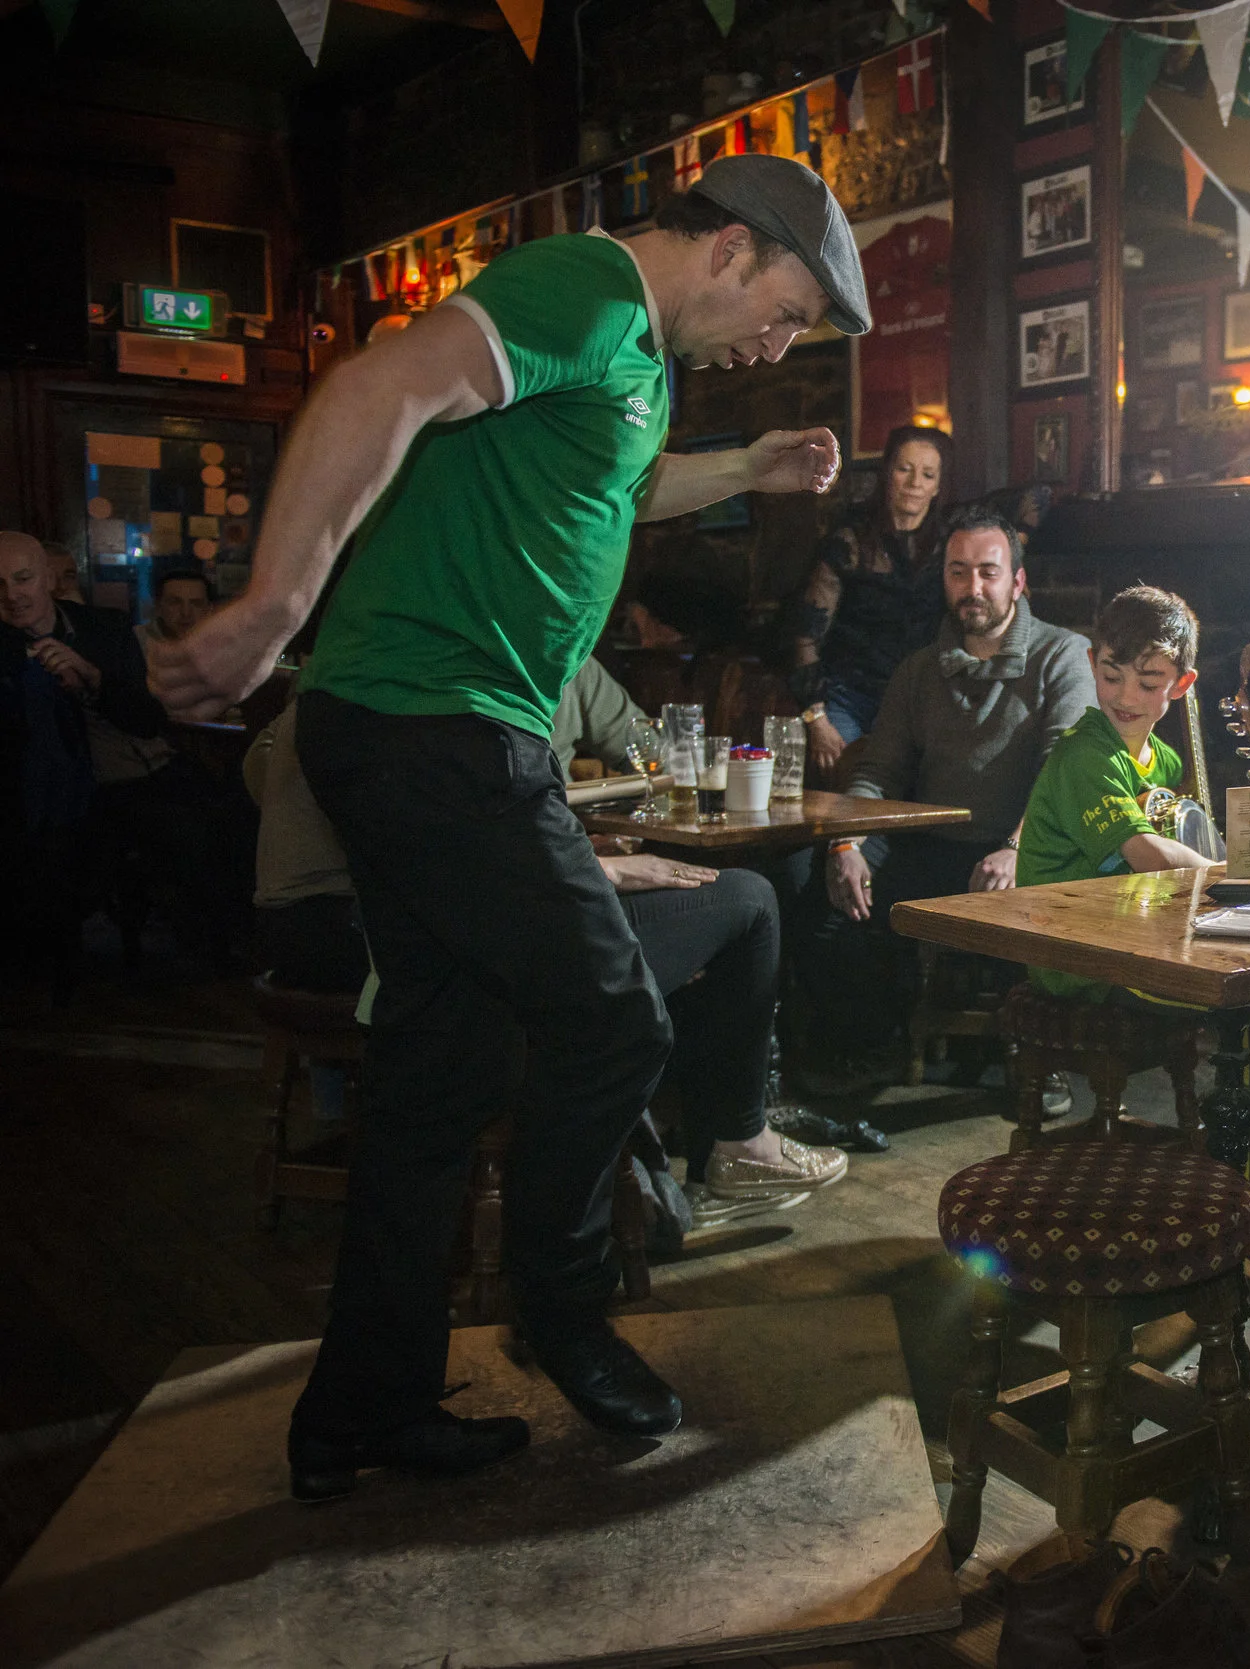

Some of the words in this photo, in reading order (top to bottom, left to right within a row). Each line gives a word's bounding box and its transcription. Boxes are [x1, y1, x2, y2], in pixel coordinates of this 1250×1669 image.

[625, 413, 647, 429] umbro
[1082, 806, 1102, 827] The
[1096, 821, 1109, 834] in
